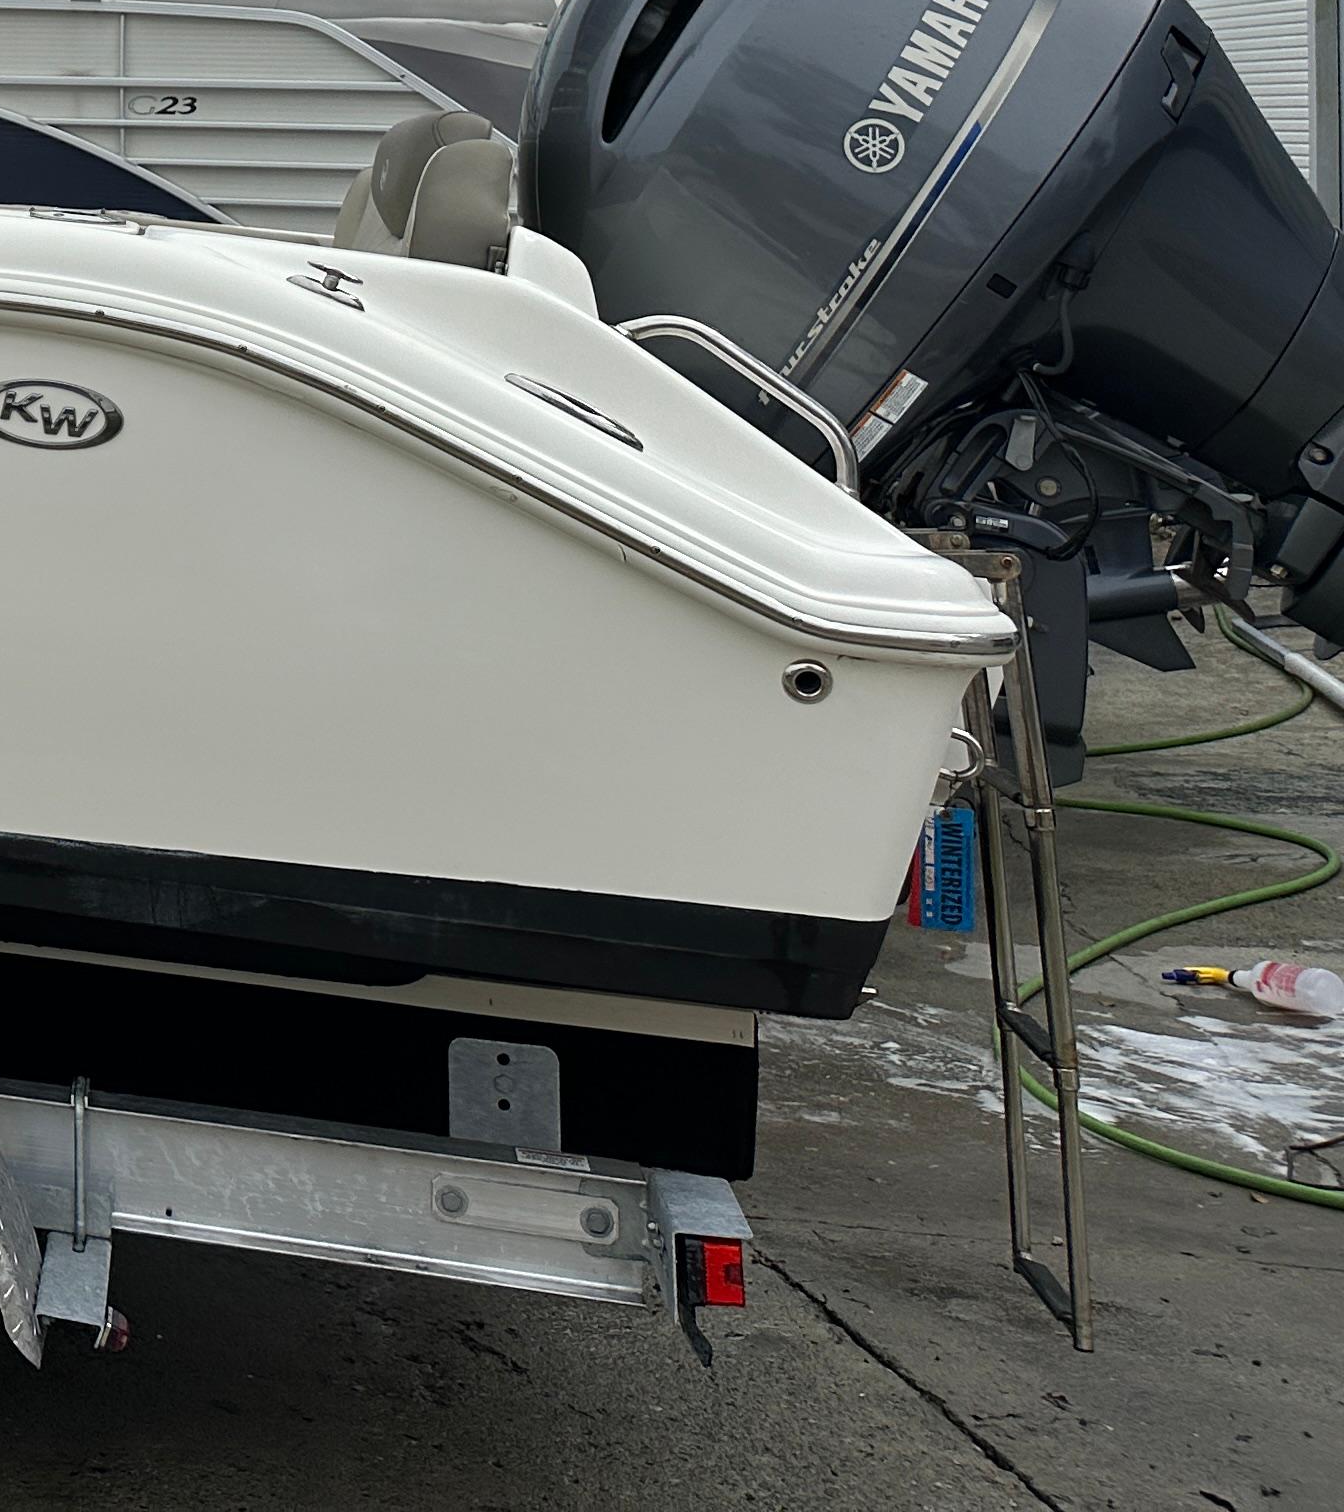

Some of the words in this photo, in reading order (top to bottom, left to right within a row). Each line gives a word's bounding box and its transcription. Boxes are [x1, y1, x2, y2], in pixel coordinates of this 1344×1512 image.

[127, 95, 198, 115] G23
[0, 390, 99, 438] KW
[941, 823, 963, 925] WINTERIZED
